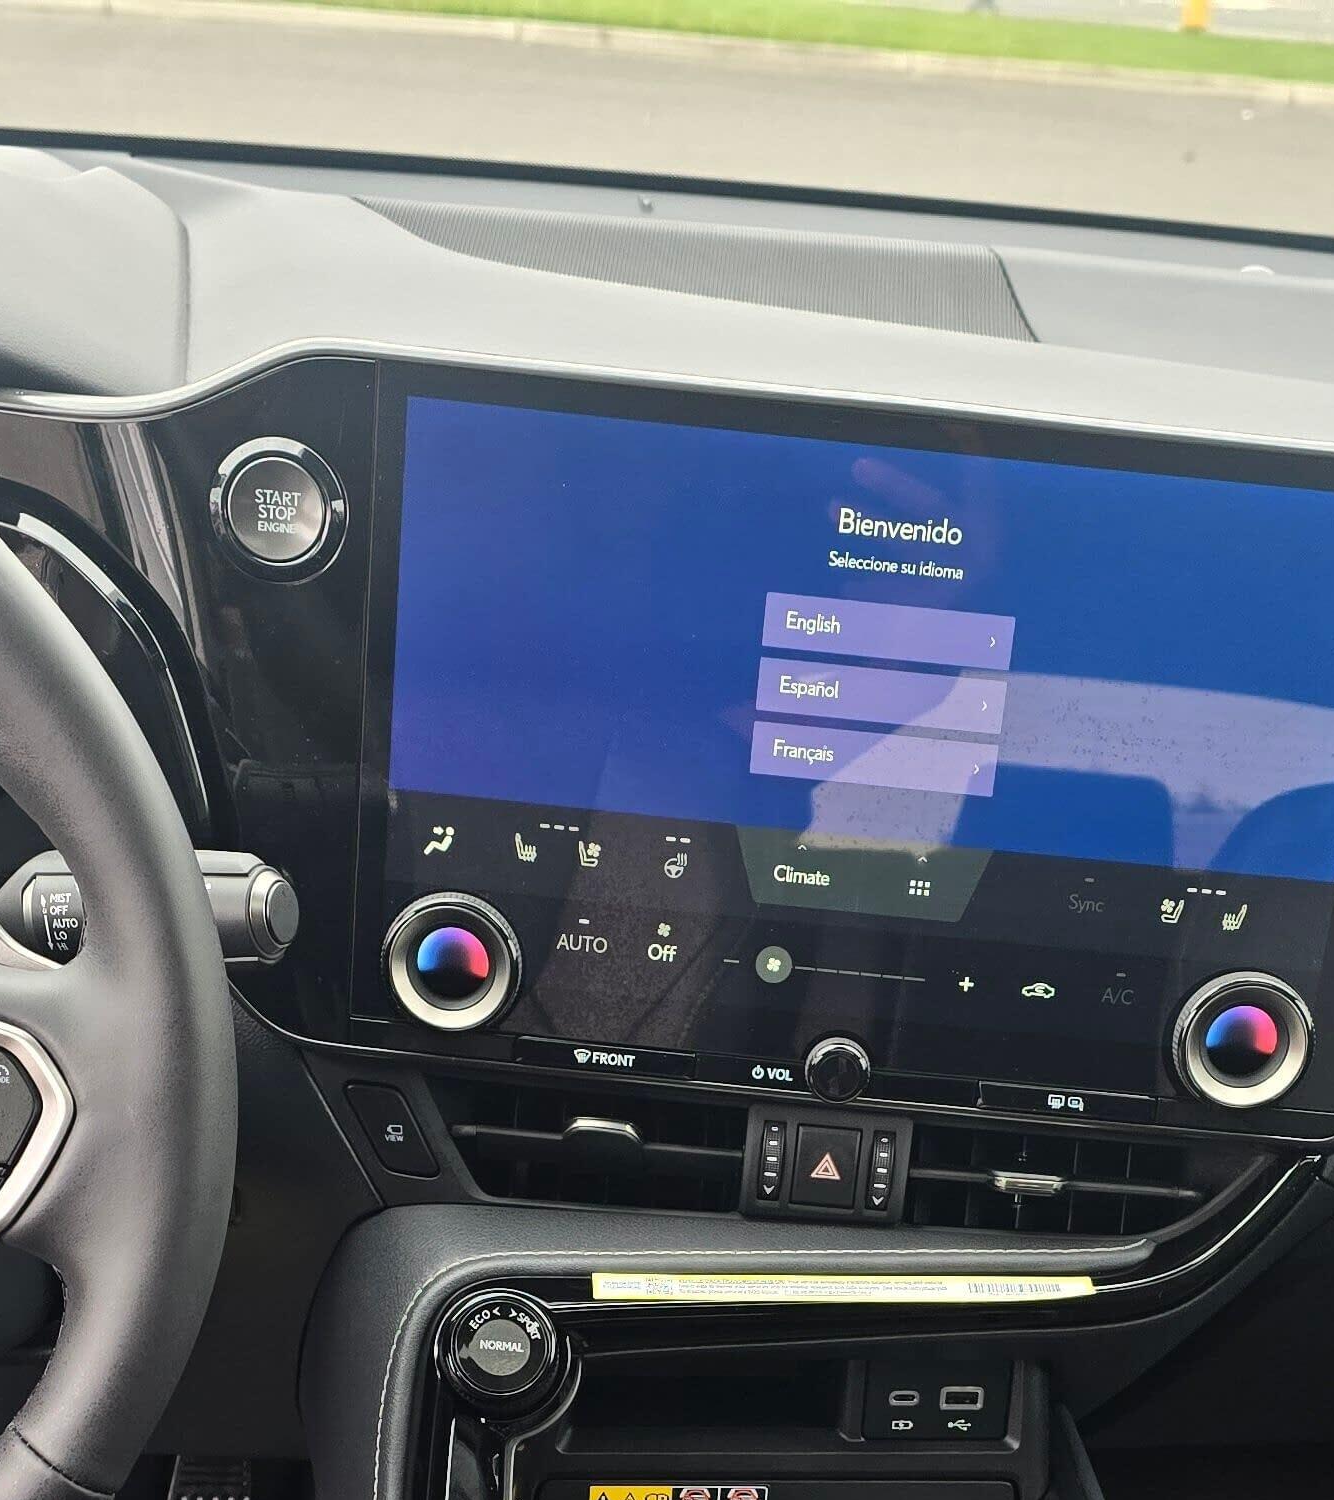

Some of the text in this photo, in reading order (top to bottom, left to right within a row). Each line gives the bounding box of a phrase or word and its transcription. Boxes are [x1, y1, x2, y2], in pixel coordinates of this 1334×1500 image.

[255, 488, 301, 507] START
[258, 504, 296, 521] STOP
[257, 521, 298, 534] ENGINE
[838, 507, 963, 546] Bienvenido
[828, 550, 964, 580] Seleccione su idioma
[785, 610, 841, 635] English
[779, 675, 839, 700] Español
[772, 739, 834, 765] Français
[773, 864, 830, 887] Climate
[49, 892, 71, 904] MIST
[1068, 893, 1105, 914] Sync
[49, 905, 68, 916] OFF
[52, 917, 79, 929] AUTO
[54, 930, 68, 941] LO
[556, 933, 608, 954] AUTO
[647, 943, 678, 963] Off
[1101, 987, 1135, 1006] A/C
[592, 1050, 636, 1068] FRONT
[767, 1067, 793, 1082] VOL
[384, 1133, 405, 1143] VIEW
[469, 1309, 491, 1331] ECO
[517, 1312, 542, 1340] SPORT
[479, 1339, 525, 1353] NORMAL
